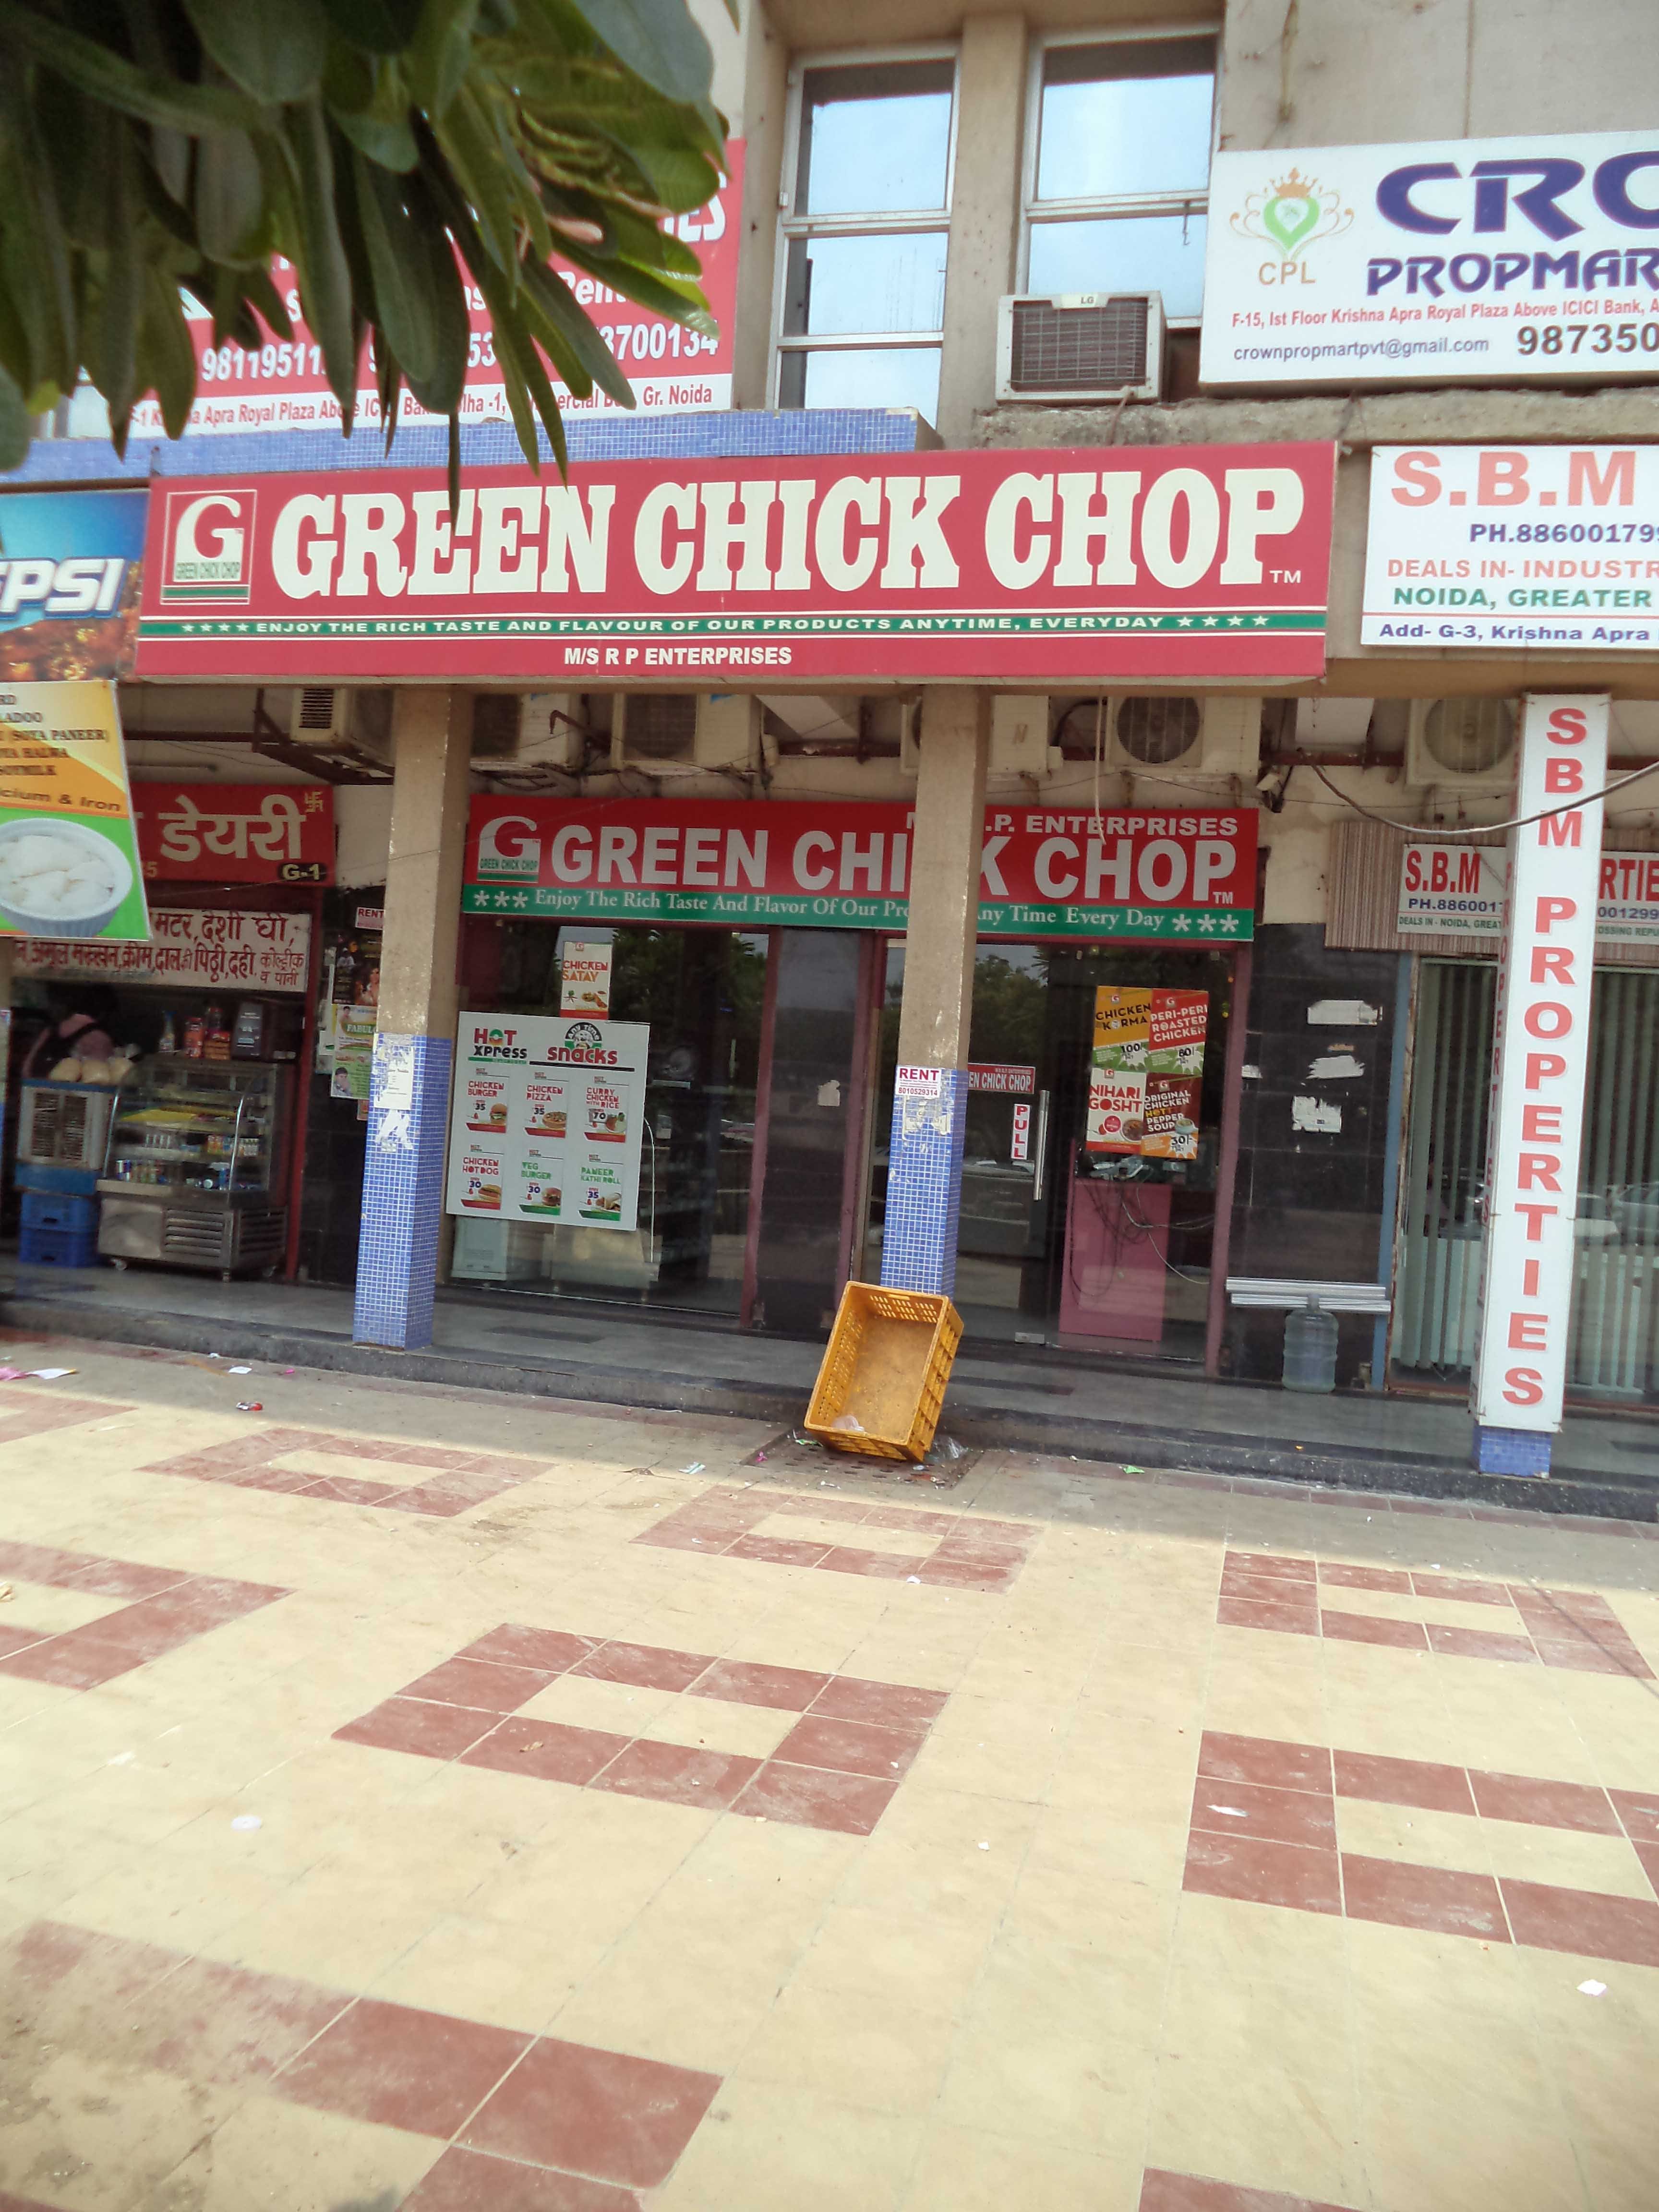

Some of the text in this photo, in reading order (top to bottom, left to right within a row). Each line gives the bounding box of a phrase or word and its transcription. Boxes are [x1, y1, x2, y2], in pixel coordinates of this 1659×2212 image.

[1259, 261, 1315, 286] CPL
[1232, 313, 1264, 328] F-15,
[1291, 308, 1327, 325] Floor
[1331, 305, 1384, 323] Krishna
[1389, 306, 1422, 323] Apra
[1428, 303, 1467, 321] Royal
[1471, 302, 1508, 318] Plaza
[1514, 301, 1557, 316] Above
[1563, 299, 1599, 315] ICICI
[1604, 298, 1645, 316] Bank,
[1234, 337, 1489, 361] crownpropmartpvt@gmail.com
[201, 342, 326, 382] 981195111
[204, 405, 234, 427] Apra
[239, 403, 275, 426] Royal
[278, 401, 315, 421] Plaza
[318, 399, 361, 419] Aboe
[643, 385, 664, 406] Gr.
[668, 384, 712, 405] Noida
[1391, 451, 1636, 506] S.B.M
[272, 467, 1305, 600] GREEN CHICK CHOP TM
[1469, 524, 1659, 543] PH.88600179
[1388, 559, 1471, 577] DEALS
[1393, 588, 1652, 611] NOIDA, GREATER
[256, 616, 1164, 633] ENJOY THE RICH TASTE AND FLAVOUR OF OUR PRODUCTS ANYTIME, EVERYDAY
[1379, 624, 1650, 644] Add- G-3, Krishna Apra
[564, 647, 792, 665] M/S R P ENTERPRISES
[59, 794, 72, 805] &
[80, 797, 120, 811] Iron
[158, 794, 306, 862] डेयरी
[1026, 816, 1238, 836] ENTERPRISES
[282, 864, 321, 880] G-1
[551, 825, 769, 888] GREEN
[1034, 837, 1236, 902] CHOP
[1213, 891, 1233, 904] TM
[1405, 850, 1482, 894] S.B.M
[358, 908, 384, 918] RENT
[535, 890, 581, 910] Enjoy
[586, 891, 617, 907] The
[624, 891, 661, 908] Rich
[666, 894, 708, 910] Taste
[713, 895, 748, 911] And
[754, 896, 806, 914] Flavor
[813, 899, 838, 915] Of
[841, 899, 878, 916] Our
[1009, 905, 1057, 923] Time
[1065, 907, 1120, 929] Every
[1126, 909, 1165, 930] Day
[1408, 899, 1503, 912] PH.886001
[1399, 917, 1421, 926] DEALS
[1425, 918, 1433, 926] IN
[563, 961, 608, 971] CHICKEN
[562, 970, 599, 982] SATAY
[1096, 1002, 1208, 1022] CHICKEN PERI-PERI
[1102, 1015, 1206, 1032] KORMA ROASTED
[474, 1028, 517, 1046] HOT
[1154, 1026, 1206, 1043] CHICKEN
[899, 1068, 939, 1081] RENT
[982, 1072, 1007, 1090] CHICK
[1009, 1075, 1031, 1091] CHOP
[468, 1081, 505, 1090] CHICKEN
[527, 1085, 563, 1095] CHICKEN
[468, 1088, 619, 1103] BURGER PIZZA CHICKEN
[898, 1087, 938, 1095] 8010529314
[1090, 1084, 1191, 1103] NIHARI ORIGINAL
[1089, 1097, 1190, 1113] GOSHT CHICKEN
[1147, 1113, 1184, 1125] PEPPER
[1148, 1121, 1175, 1132] SOUP
[1014, 1105, 1027, 1158] PULL
[463, 1157, 613, 1177] CHICKEN VEG PANEER
[521, 1170, 551, 1180] BURGER
